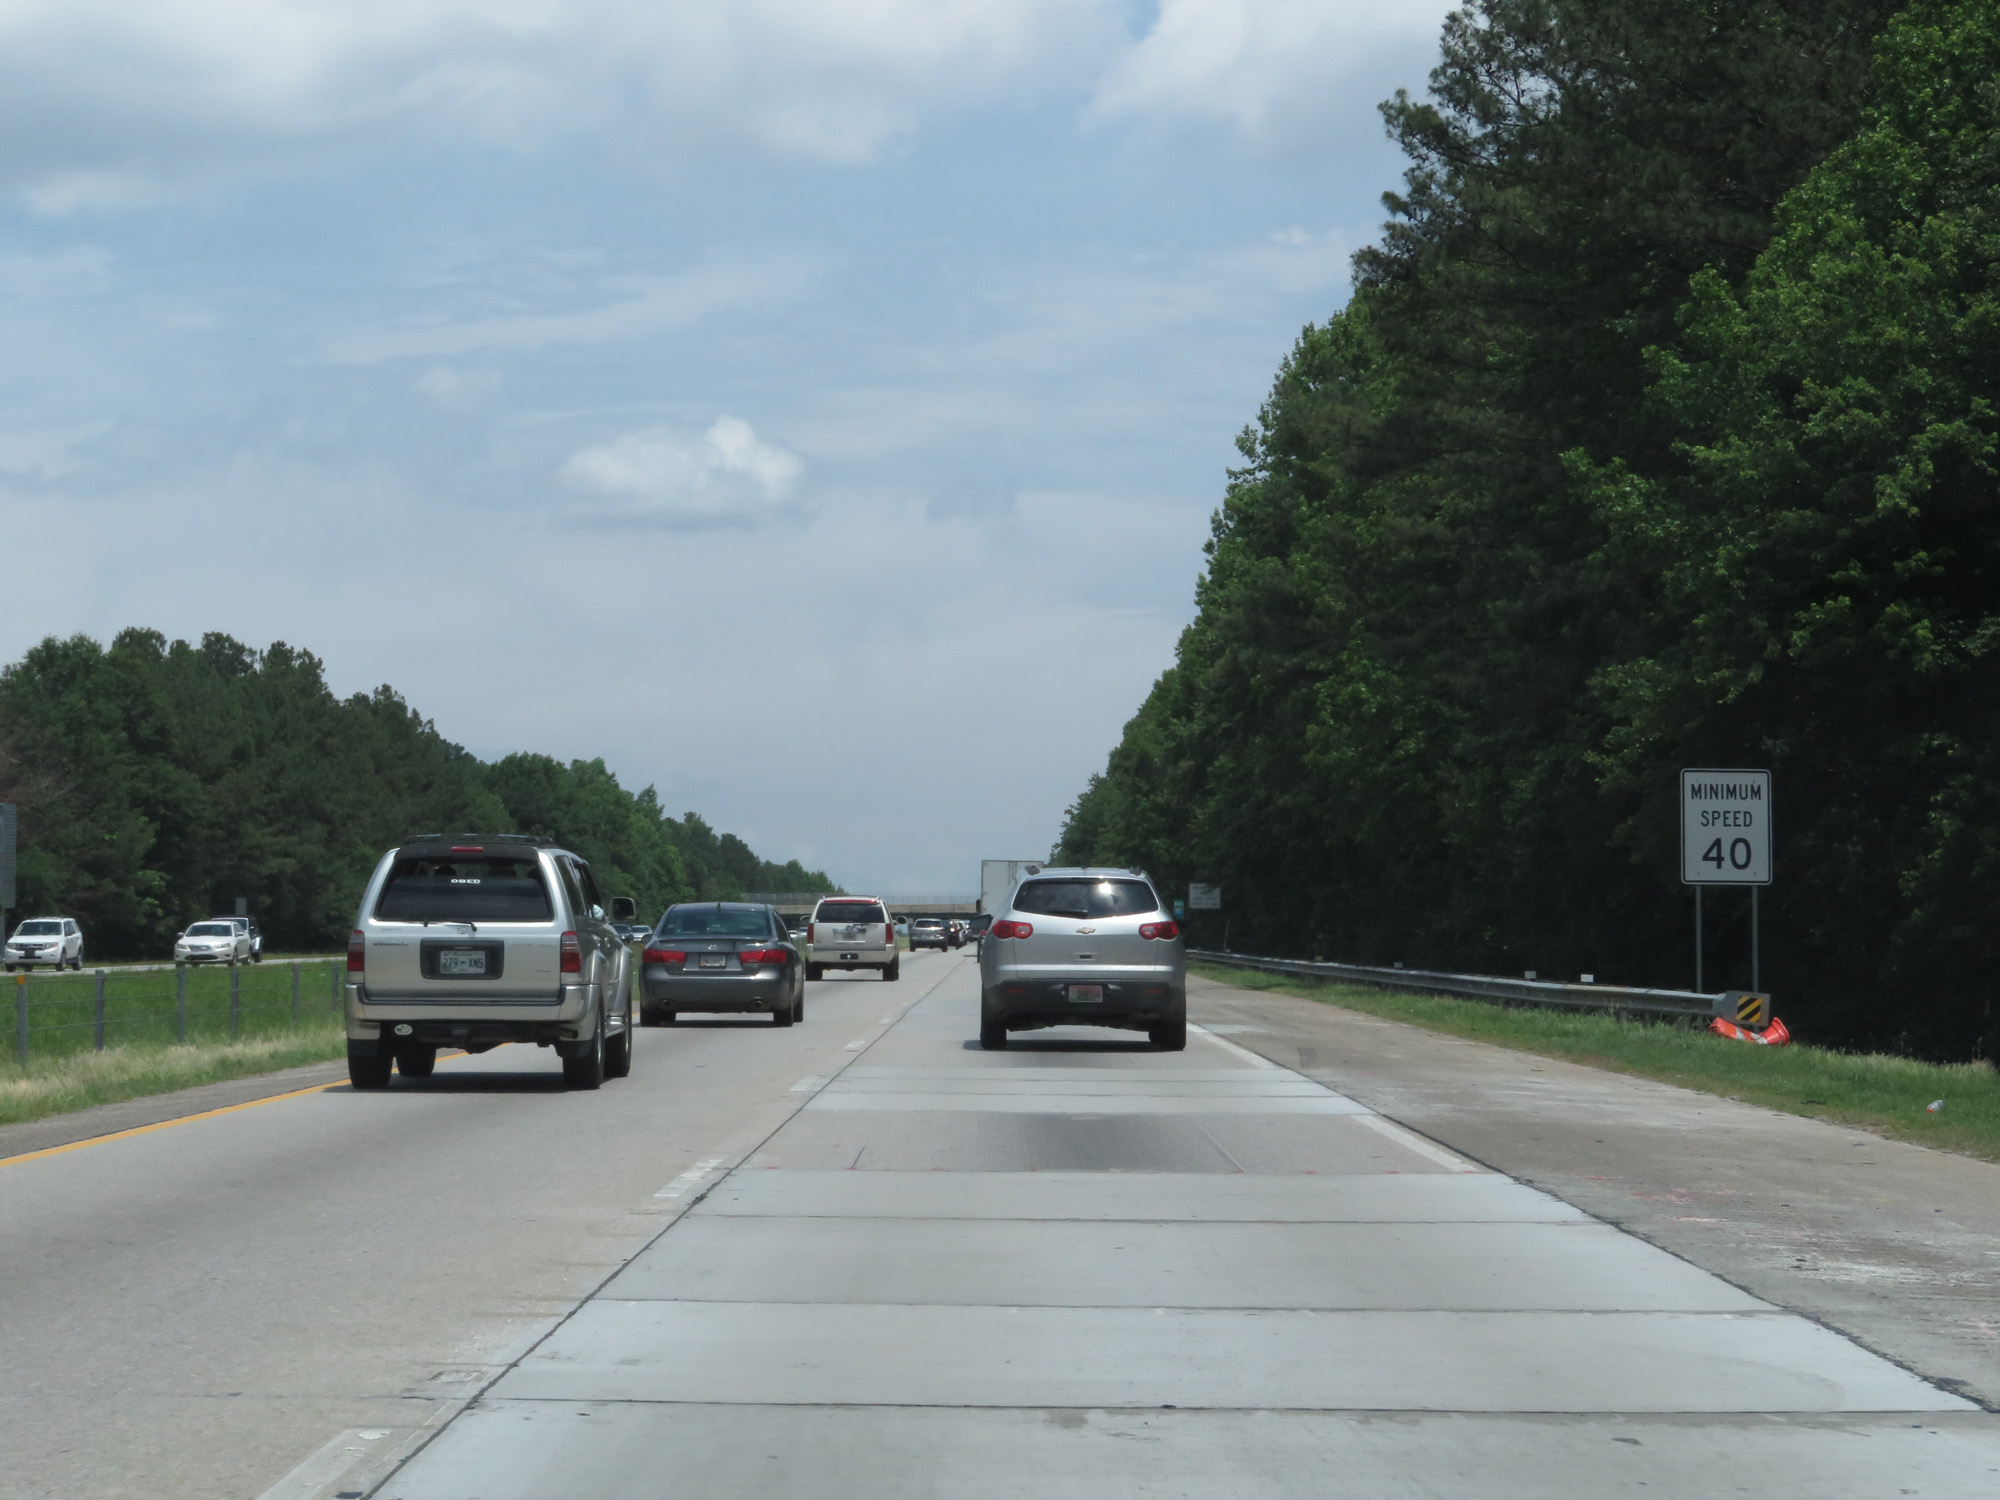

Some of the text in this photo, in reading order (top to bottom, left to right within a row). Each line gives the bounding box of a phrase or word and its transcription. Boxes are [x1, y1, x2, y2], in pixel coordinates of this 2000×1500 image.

[1691, 784, 1761, 800] MINIMUM
[1700, 810, 1753, 827] SPEED
[1702, 837, 1752, 870] 40
